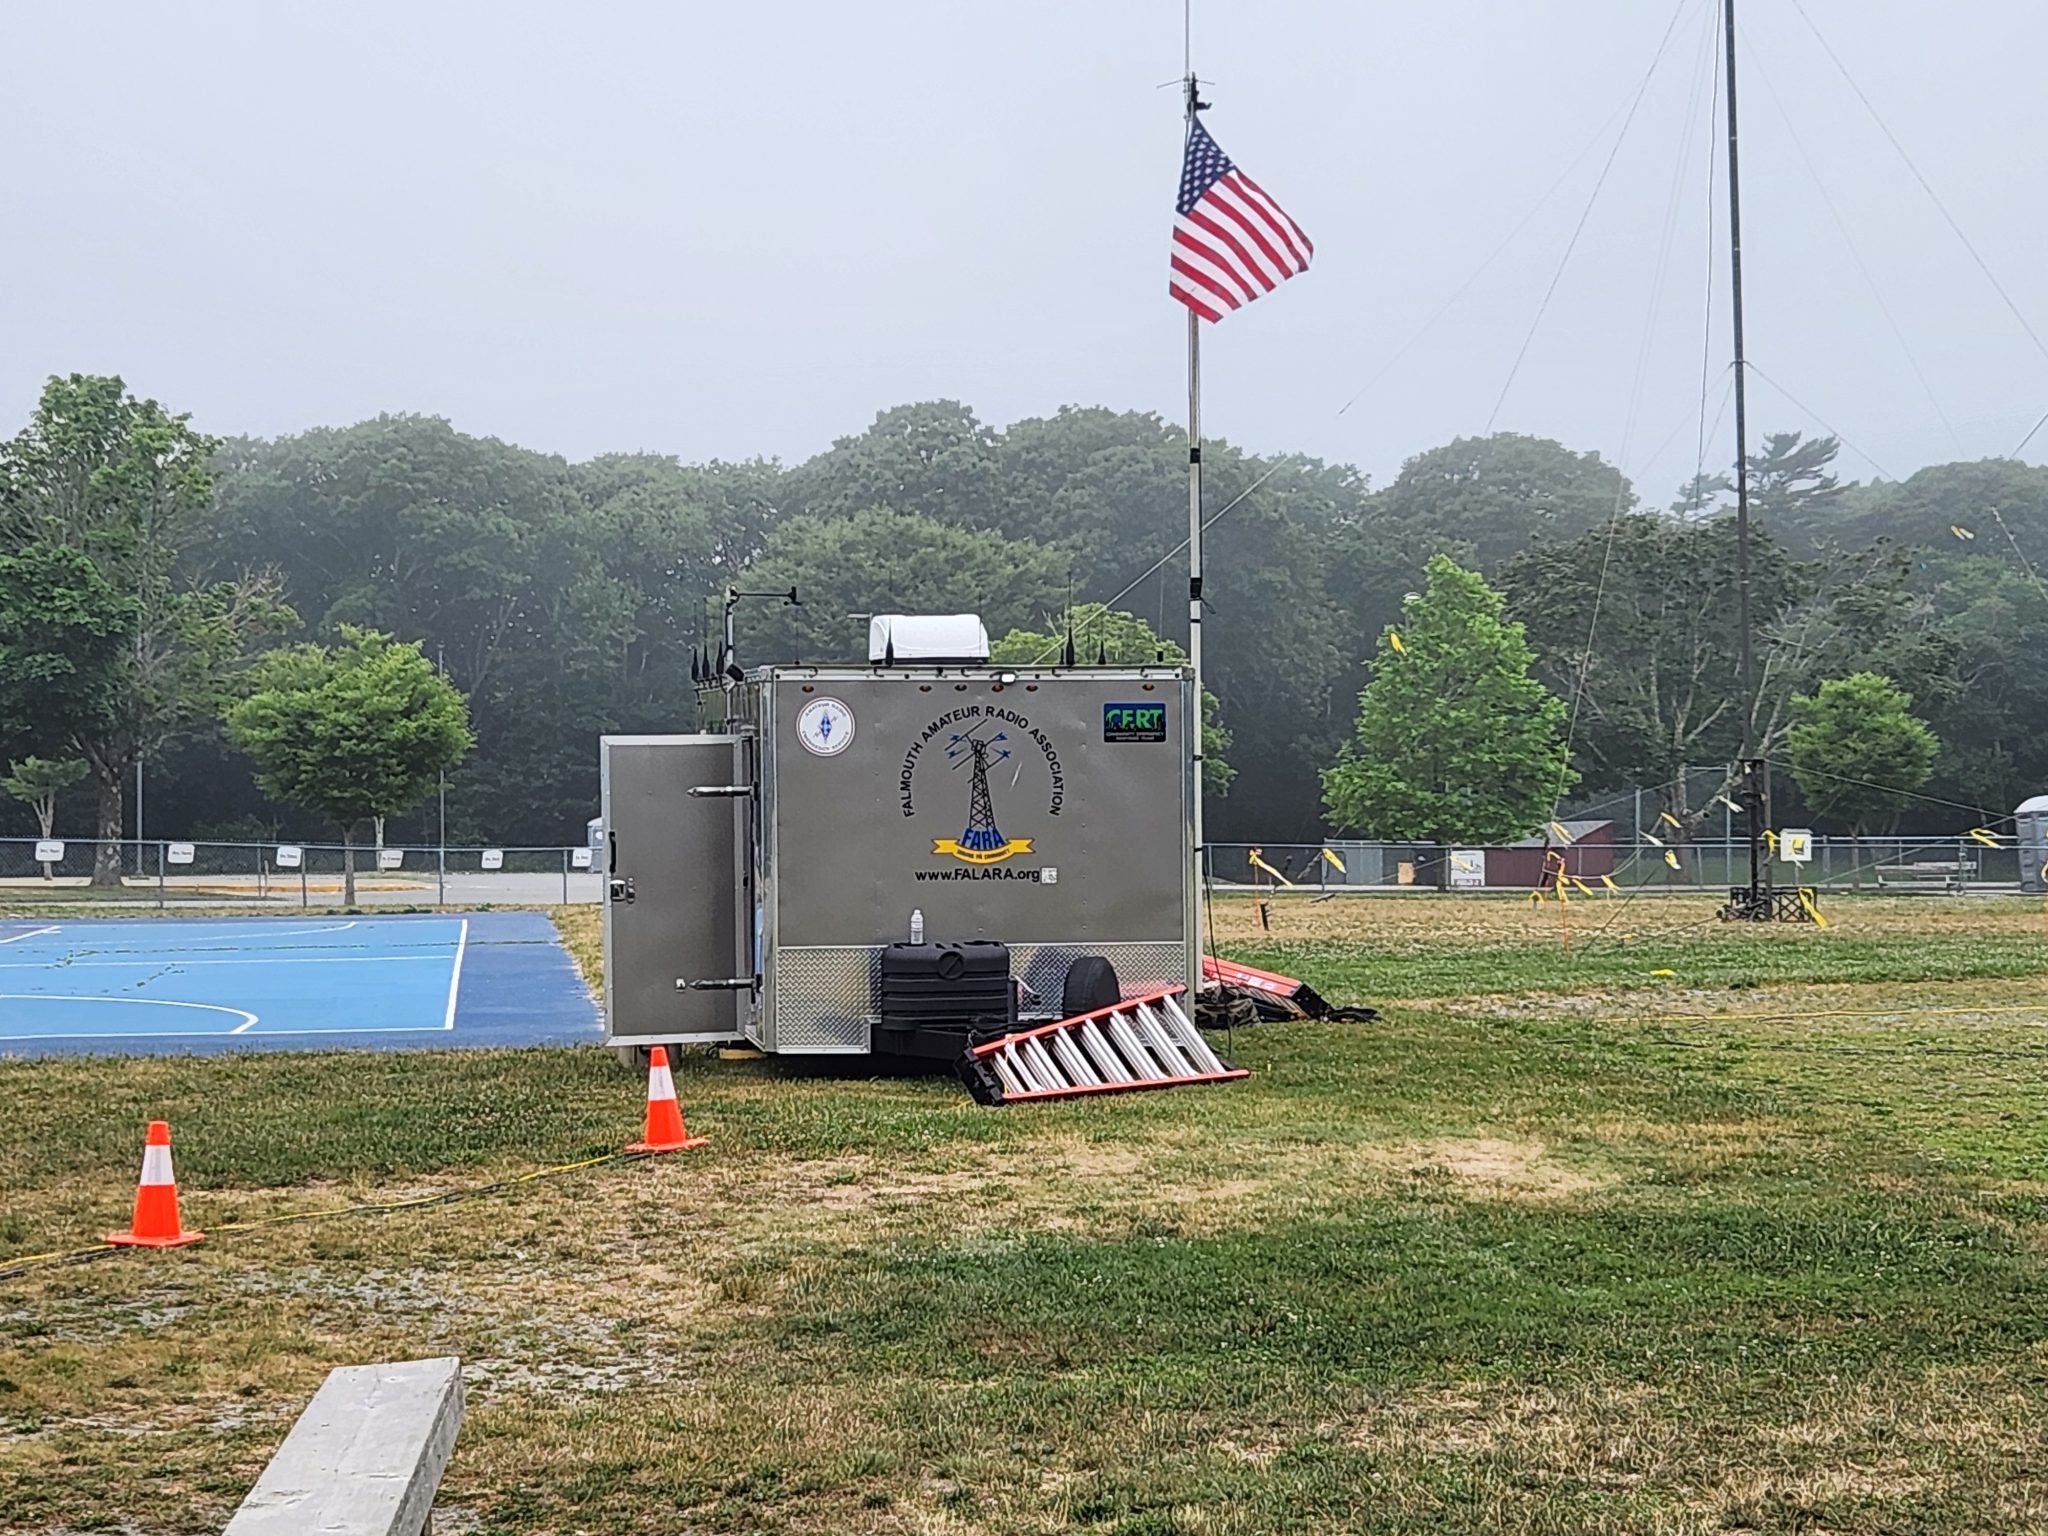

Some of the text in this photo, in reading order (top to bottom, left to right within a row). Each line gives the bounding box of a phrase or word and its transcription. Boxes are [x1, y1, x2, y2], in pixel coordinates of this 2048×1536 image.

[900, 706, 1064, 818] FALMOUTH AMATEUR RADIO ASSOCIATION
[961, 828, 1006, 850] FARA
[915, 868, 1040, 883] www.FALARA.org
